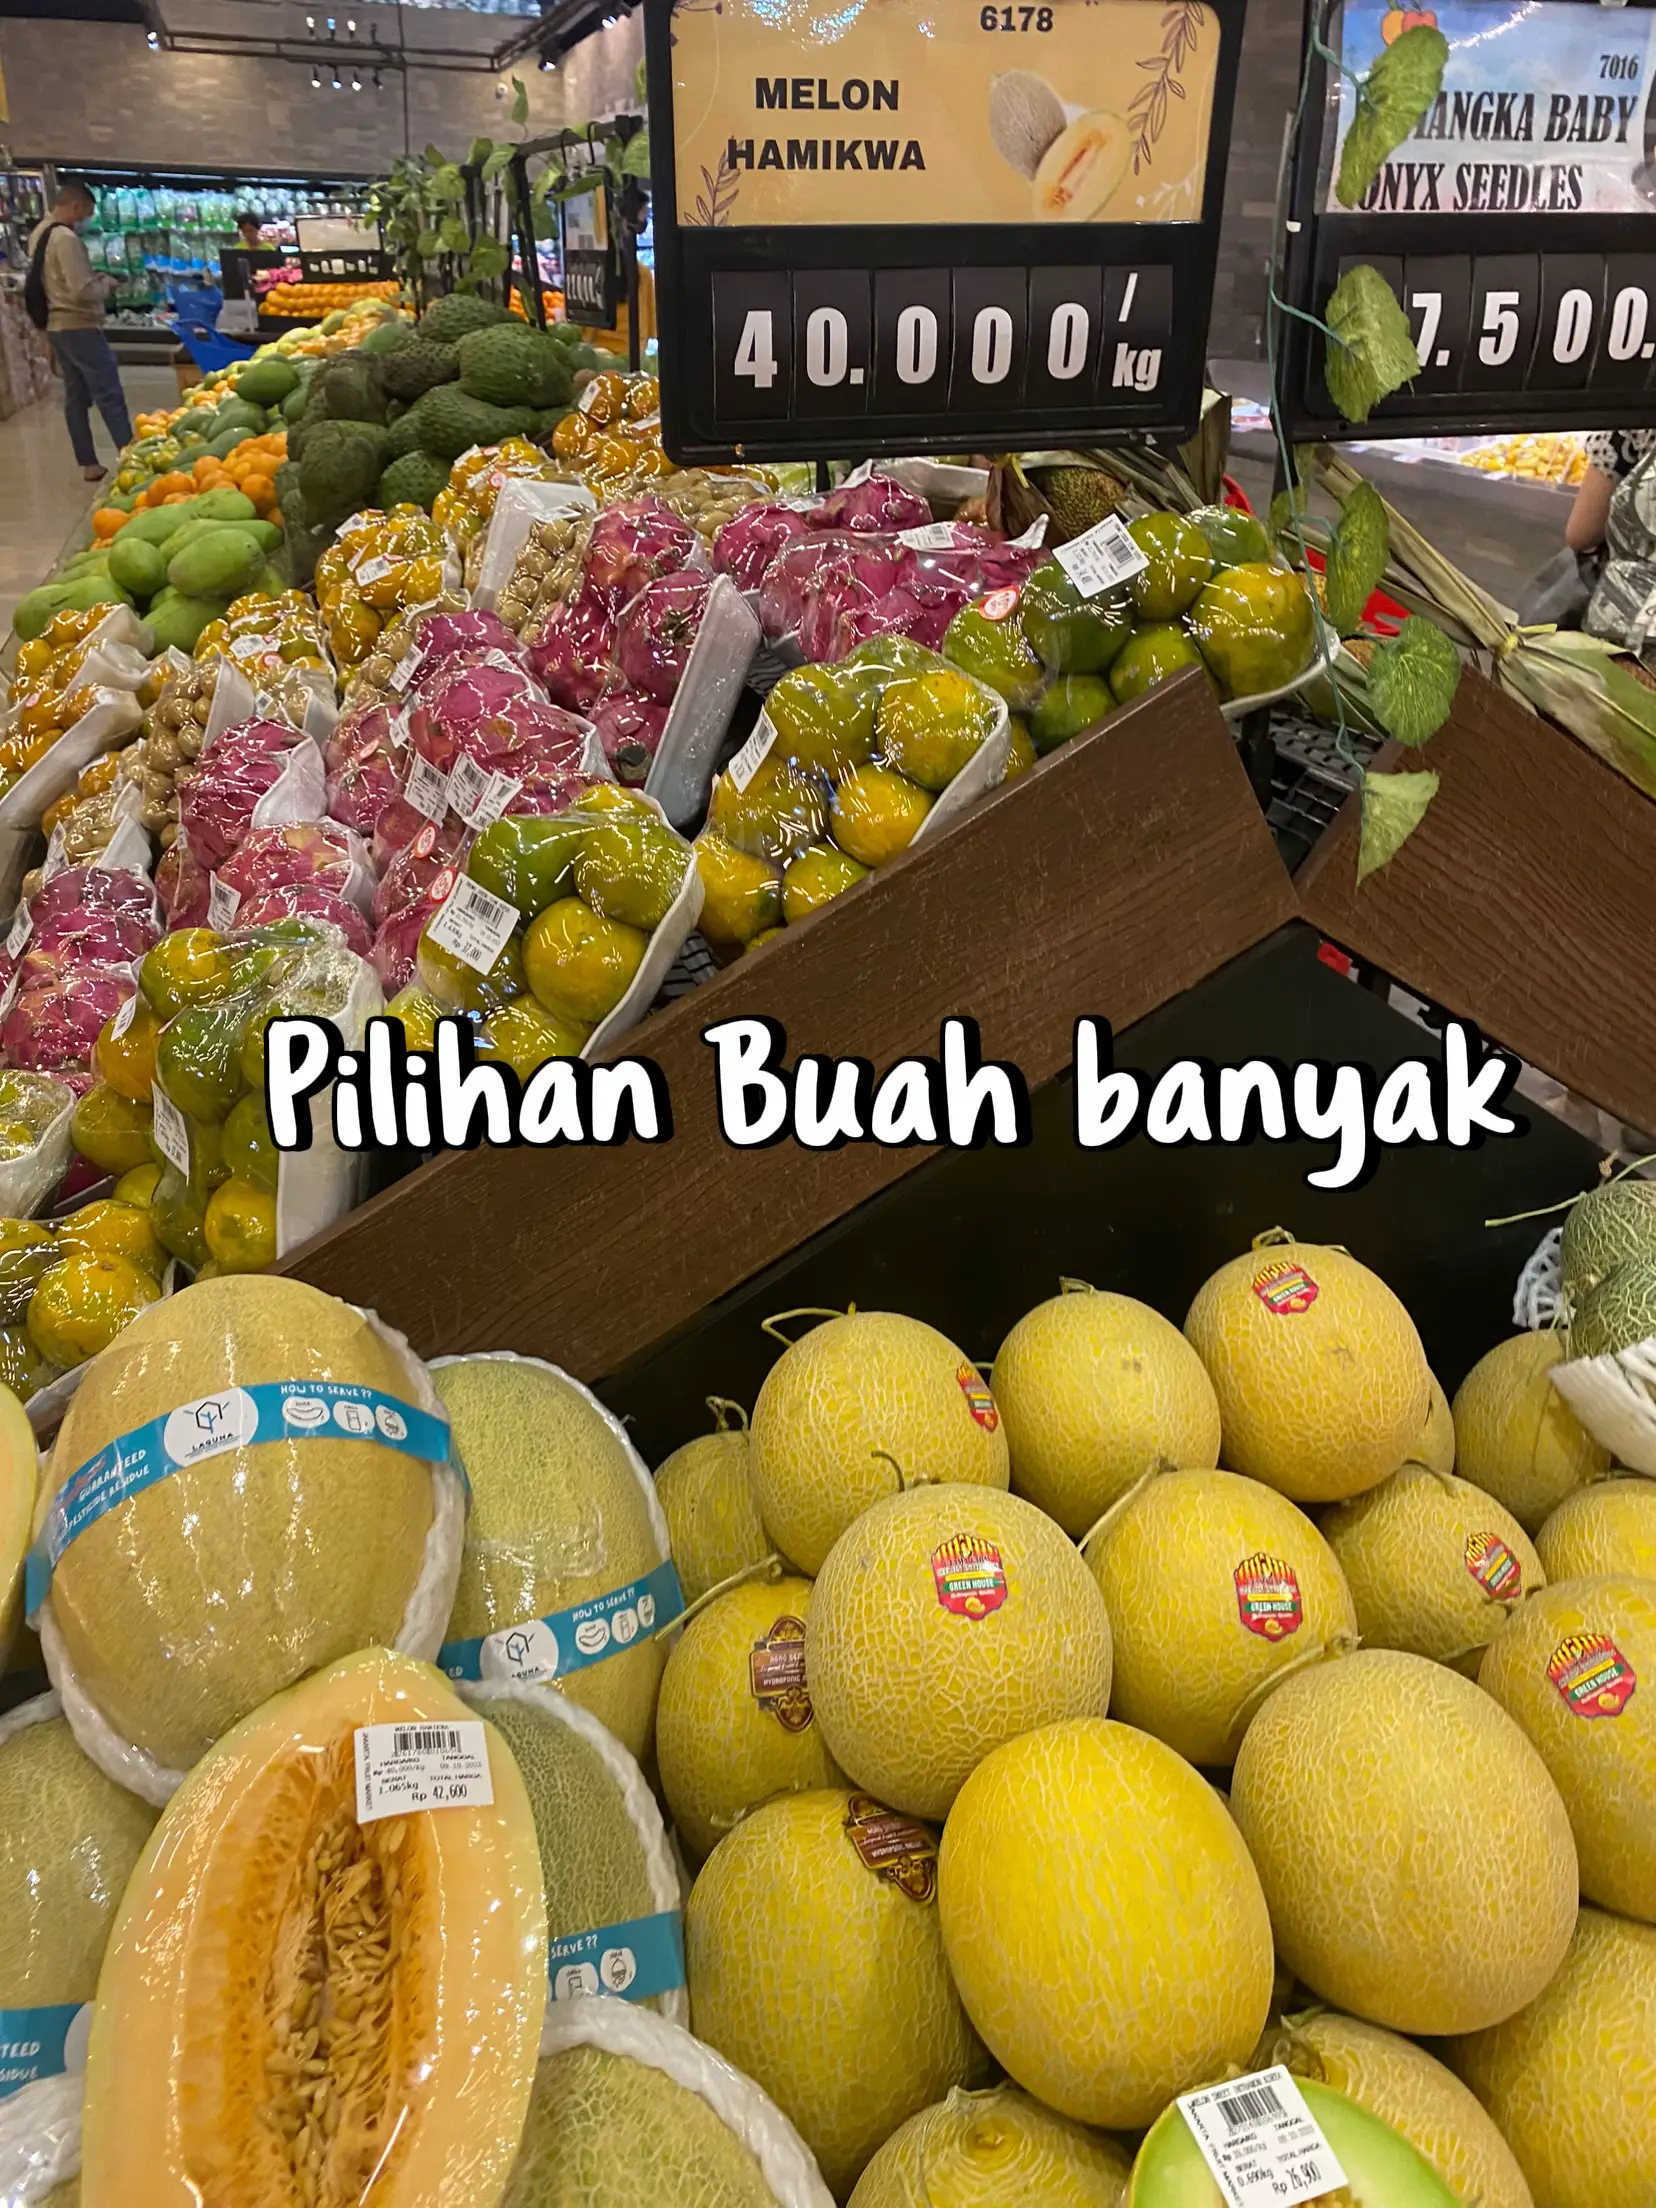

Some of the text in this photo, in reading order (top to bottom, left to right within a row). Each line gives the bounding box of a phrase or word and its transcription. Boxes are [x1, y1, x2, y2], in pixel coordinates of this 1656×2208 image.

[980, 5, 1053, 32] 6178
[1599, 54, 1638, 80] 7016
[754, 77, 900, 111] MELON
[1414, 90, 1639, 143] ANGKA BABY
[727, 138, 926, 170] HAMIKWA
[1452, 163, 1584, 211] SEEDLES
[280, 1384, 306, 1395] HOW
[309, 1384, 324, 1394] TO
[327, 1386, 359, 1397] SERVE
[572, 1607, 592, 1623] HOW
[593, 1601, 605, 1613] TO
[411, 1783, 468, 1802] Rp 42,600
[551, 1938, 583, 1960] SERVE
[1272, 2181, 1288, 2195] Rp
